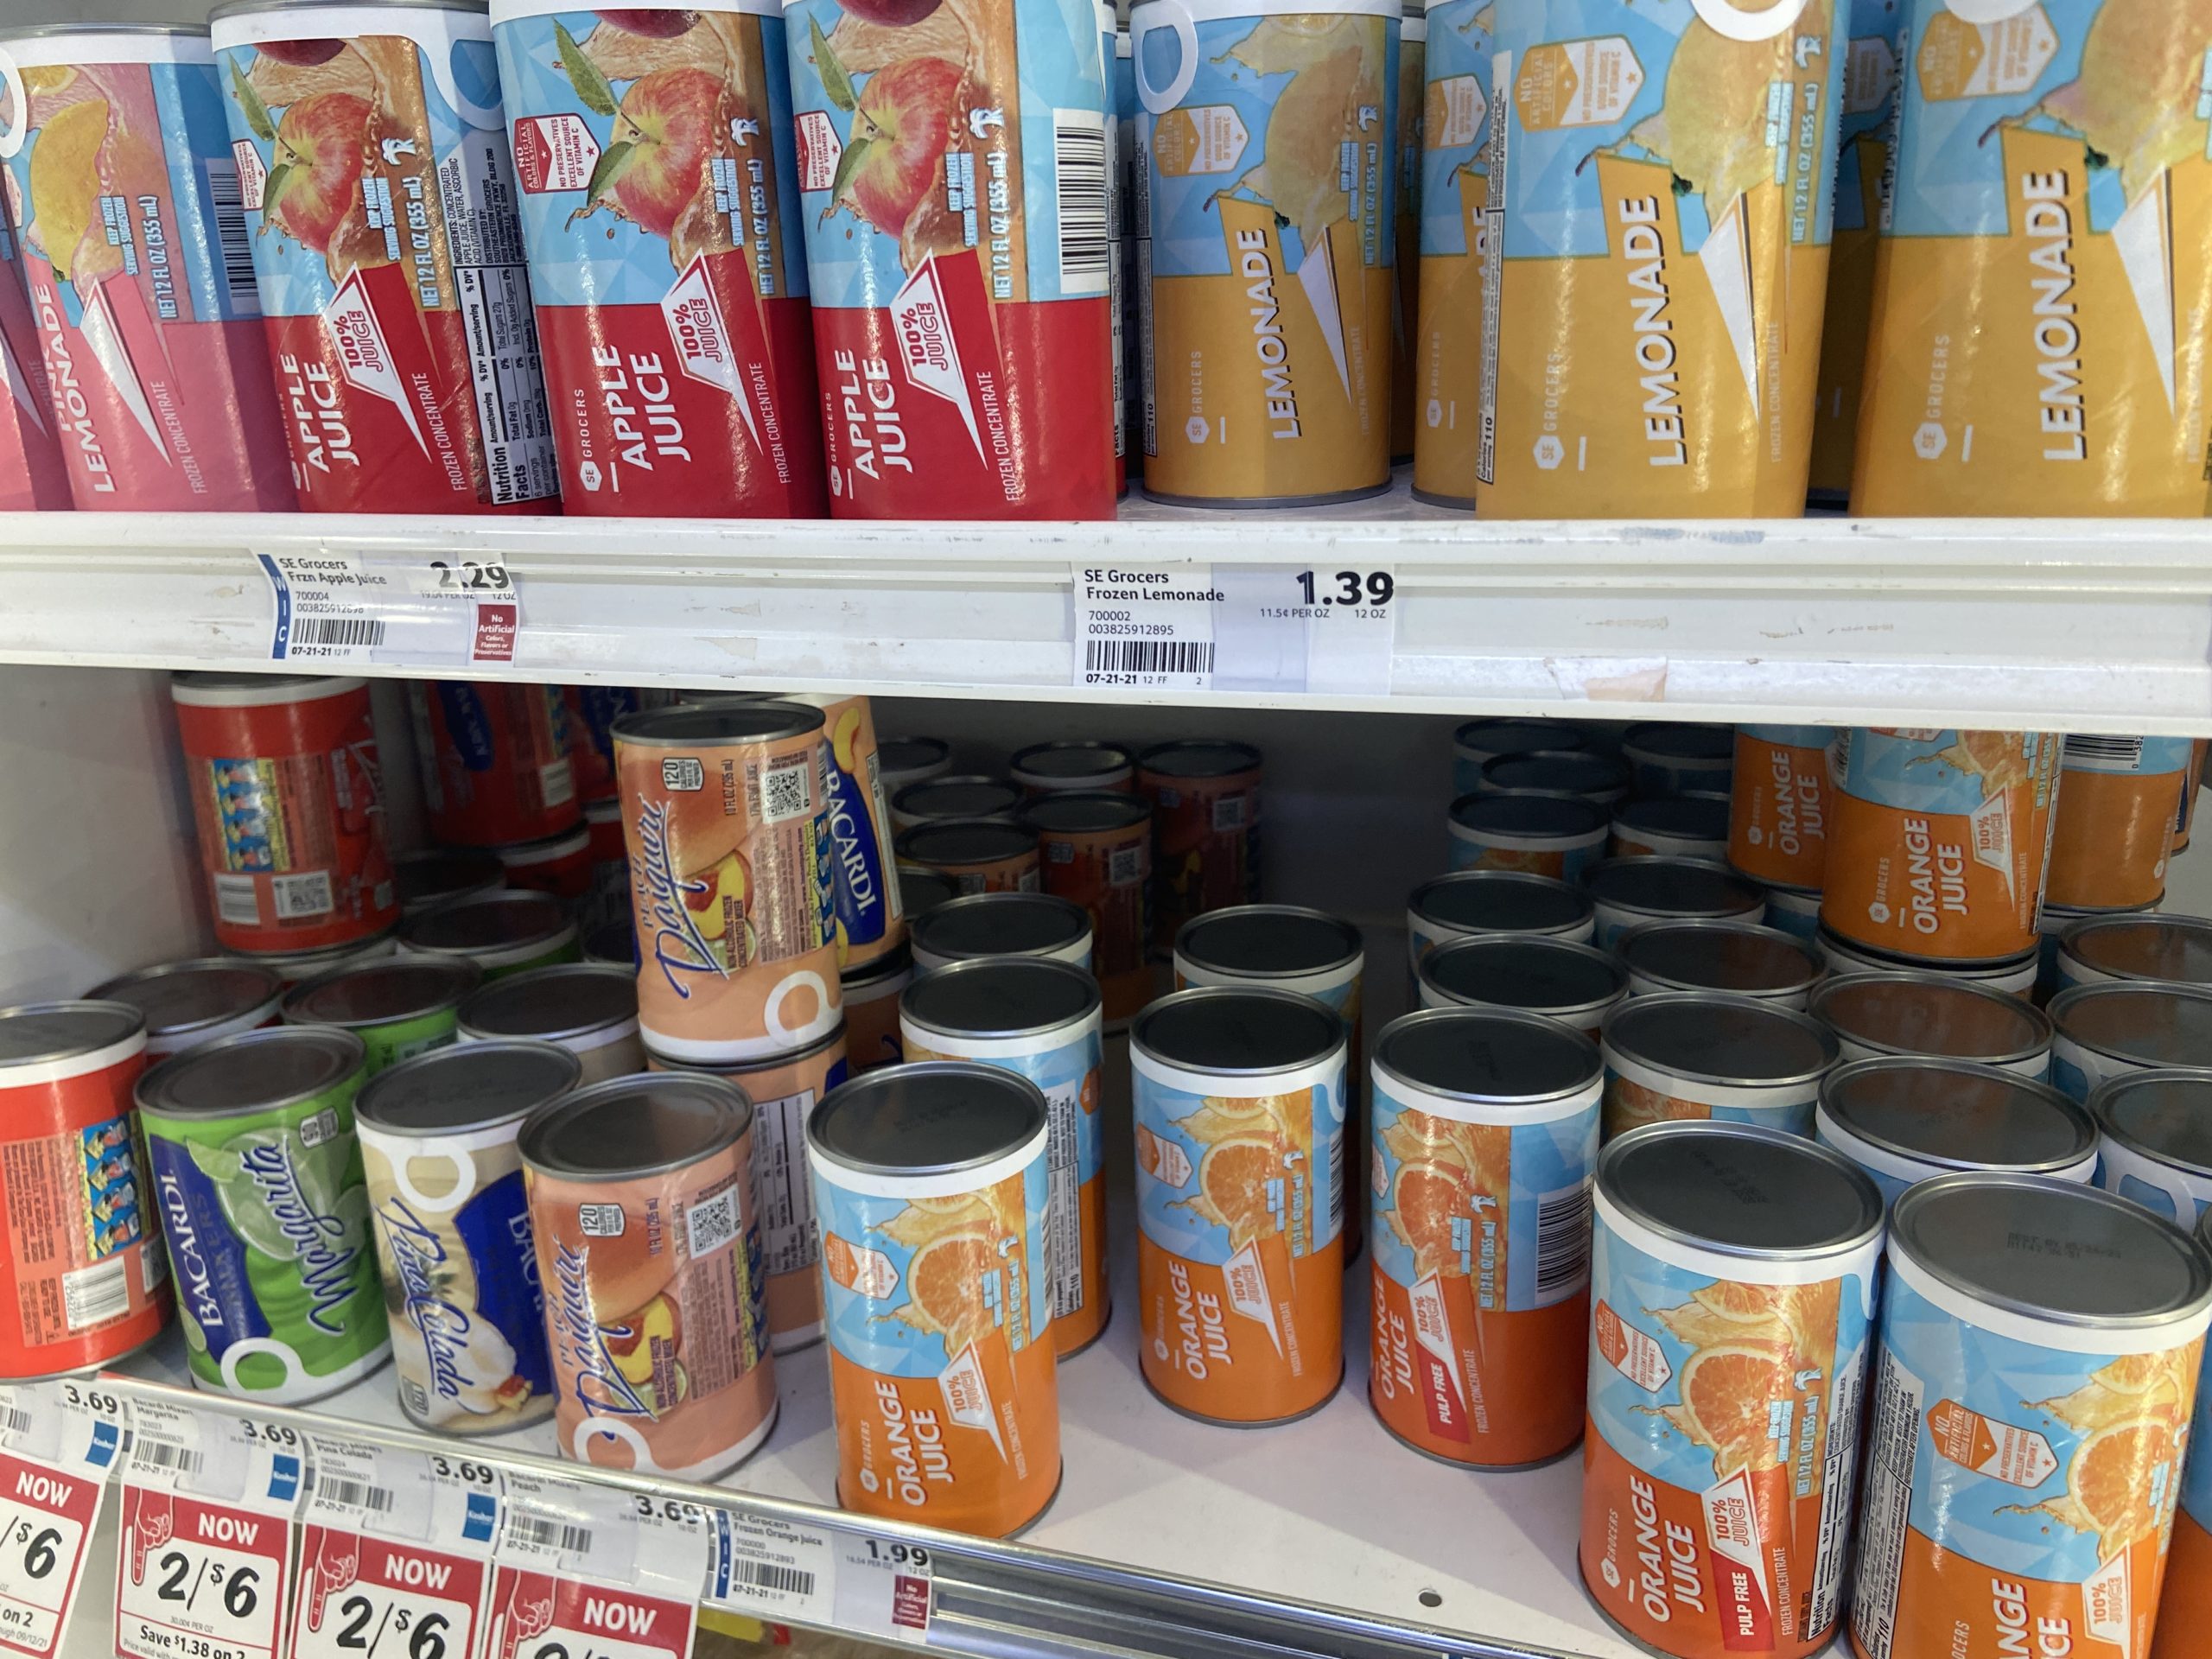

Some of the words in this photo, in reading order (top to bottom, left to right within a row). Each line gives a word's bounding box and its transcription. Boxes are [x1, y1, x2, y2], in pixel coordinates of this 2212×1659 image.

[551, 119, 565, 175] PRESERVATIVES
[561, 118, 571, 145] SOURCE
[572, 135, 582, 164] VITAMIN
[517, 147, 525, 168] NO
[566, 148, 577, 188] EXCELLENT
[747, 159, 763, 182] mL)
[402, 176, 423, 199] mL)
[750, 186, 767, 214] (355
[1795, 194, 1808, 211] 12
[100, 196, 116, 227] FROZEN
[112, 196, 133, 241] SUGGESTION
[138, 196, 158, 216] mL)
[406, 202, 429, 230] (355
[143, 219, 161, 246] (355
[411, 232, 430, 249] OZ
[753, 218, 768, 235] OZ
[990, 215, 1010, 234] OZ
[121, 241, 138, 275] SERVING
[149, 247, 168, 266] OZ
[415, 251, 433, 264] FL
[755, 238, 770, 251] FL
[757, 255, 772, 270] 12
[993, 254, 1010, 271] 12
[151, 268, 168, 281] FL
[156, 282, 173, 299] 12
[417, 267, 436, 282] 12
[760, 272, 774, 295] NET
[994, 276, 1012, 298] NET
[160, 301, 177, 318] NET
[420, 286, 440, 307] NET
[672, 303, 702, 359] 100%
[689, 297, 722, 363] JUICE
[1618, 195, 1688, 466] LEMONADE
[2022, 169, 2087, 461] LEMONADE
[334, 315, 362, 369] 100%
[346, 310, 383, 372] JUICE
[900, 308, 927, 366] 100%
[916, 302, 948, 371] JUICE
[1236, 228, 1302, 439] LEMONADE
[35, 283, 118, 493] LEMONADE
[1191, 351, 1202, 414] GROCERS
[1544, 353, 1561, 431] GROCERS
[1926, 334, 1950, 419] GROCERS
[150, 381, 190, 452] CONCENTRATE
[280, 353, 330, 473] APPLE
[304, 361, 360, 467] JUICE
[411, 373, 450, 449] CONCENTRATE
[591, 345, 653, 471] APPLE
[629, 352, 691, 462] JUICE
[748, 362, 781, 445] CONCENTRATE
[835, 348, 880, 480] APPLE
[862, 359, 913, 474] JUICE
[976, 371, 1009, 458] CONCENTRATE
[574, 388, 593, 457] GROCERS
[825, 393, 836, 462] GROCERS
[1192, 424, 1202, 436] SE
[1484, 417, 1493, 441] 110
[1922, 431, 1936, 448] SE
[186, 452, 207, 494] FROZEN
[441, 450, 467, 493] FROZEN
[493, 447, 513, 502] Nutrition
[516, 465, 530, 499] Facts
[585, 469, 595, 483] SE
[772, 446, 791, 484] FROZEN
[998, 460, 1020, 501] FROZEN
[279, 558, 297, 569] SE
[298, 558, 347, 569] Grocers
[288, 571, 316, 582] Frzn
[318, 572, 355, 586] Apple
[355, 573, 387, 586] Juice
[430, 561, 510, 589] 2.29
[1084, 570, 1103, 582] SE
[1108, 570, 1169, 583] Grocers
[296, 591, 329, 601] 700004
[1087, 588, 1138, 600] Frozen
[1143, 588, 1224, 601] Lemonade
[1296, 570, 1395, 606] 1.39
[479, 624, 514, 634] Artificial
[492, 614, 503, 623] No
[1089, 611, 1131, 621] 700002
[1089, 624, 1173, 635] 003825912895
[1292, 608, 1313, 619] PER
[1314, 608, 1331, 619] OZ
[1355, 609, 1368, 619] 12
[1370, 609, 1386, 619] OZ
[291, 647, 332, 656] 07-21-21
[1085, 674, 1137, 684] 07-21-21
[1143, 676, 1153, 684] 12
[665, 762, 679, 787] 120
[1771, 750, 1799, 855] ORANGE
[1797, 774, 1825, 840] JUICE
[827, 769, 876, 912] BACARDI
[1979, 816, 1991, 851] 100%
[1990, 812, 2004, 853] JUICE
[1904, 817, 1939, 934] ORANGE
[1937, 843, 1968, 916] JUICE
[637, 791, 730, 1000] Daiquiri
[582, 1207, 598, 1232] 120
[160, 1174, 224, 1326] BACARDI
[238, 1141, 359, 1337] Margarita
[1230, 1264, 1246, 1302] 100%
[1243, 1264, 1262, 1305] JUICE
[1168, 1260, 1207, 1380] ORANGE
[1197, 1291, 1232, 1365] JUICE
[1414, 1296, 1429, 1333] 100%
[1426, 1295, 1444, 1343] JUICE
[404, 1295, 474, 1401] Colada
[1374, 1270, 1395, 1400] ORANGE
[1389, 1311, 1414, 1395] JUICE
[947, 1375, 966, 1413] 100%
[960, 1370, 983, 1411] JUICE
[1431, 1363, 1447, 1392] FREE
[1463, 1349, 1484, 1404] CONCENTRATE
[65, 1384, 118, 1414] 3.69
[1435, 1394, 1452, 1424] PULP
[239, 1418, 297, 1446] 3.69
[1474, 1405, 1490, 1433] FROZEN
[1935, 1415, 1950, 1437] NO
[1949, 1409, 1965, 1459] ARTIFICIAL
[874, 1380, 926, 1507] ORANGE
[910, 1408, 955, 1484] JUICE
[432, 1457, 493, 1484] 3.69
[511, 1479, 541, 1492] Peach
[16, 1471, 73, 1508] NOW
[635, 1495, 700, 1524] 3.69
[747, 1515, 790, 1529] Grocers
[1712, 1499, 1730, 1540] 100%
[1728, 1497, 1750, 1546] JUICE
[198, 1512, 259, 1546] NOW
[734, 1522, 764, 1536] Frozen
[766, 1528, 799, 1543] Orange
[800, 1534, 823, 1547] Juice
[865, 1539, 929, 1567] 1.99
[1630, 1474, 1670, 1623] ORANGE
[1664, 1520, 1706, 1613] JUICE
[157, 1551, 260, 1618] 2/$6
[385, 1554, 453, 1590] NOW
[908, 1566, 917, 1575] 12
[918, 1567, 931, 1577] OZ
[1732, 1573, 1749, 1601] FREE
[1773, 1547, 1790, 1605] CONCENTRATE
[3, 1608, 20, 1624] on
[22, 1611, 34, 1628] 2
[583, 1598, 657, 1636] NOW
[1737, 1605, 1754, 1636] PULP
[1780, 1605, 1793, 1636] FROZEN
[1812, 1592, 1825, 1636] Nutrition
[2092, 1583, 2107, 1624] 100%
[140, 1624, 171, 1648] Save
[175, 1635, 210, 1658] $1.38
[336, 1595, 449, 1659] 2/$6
[1877, 1618, 1890, 1638] 110
